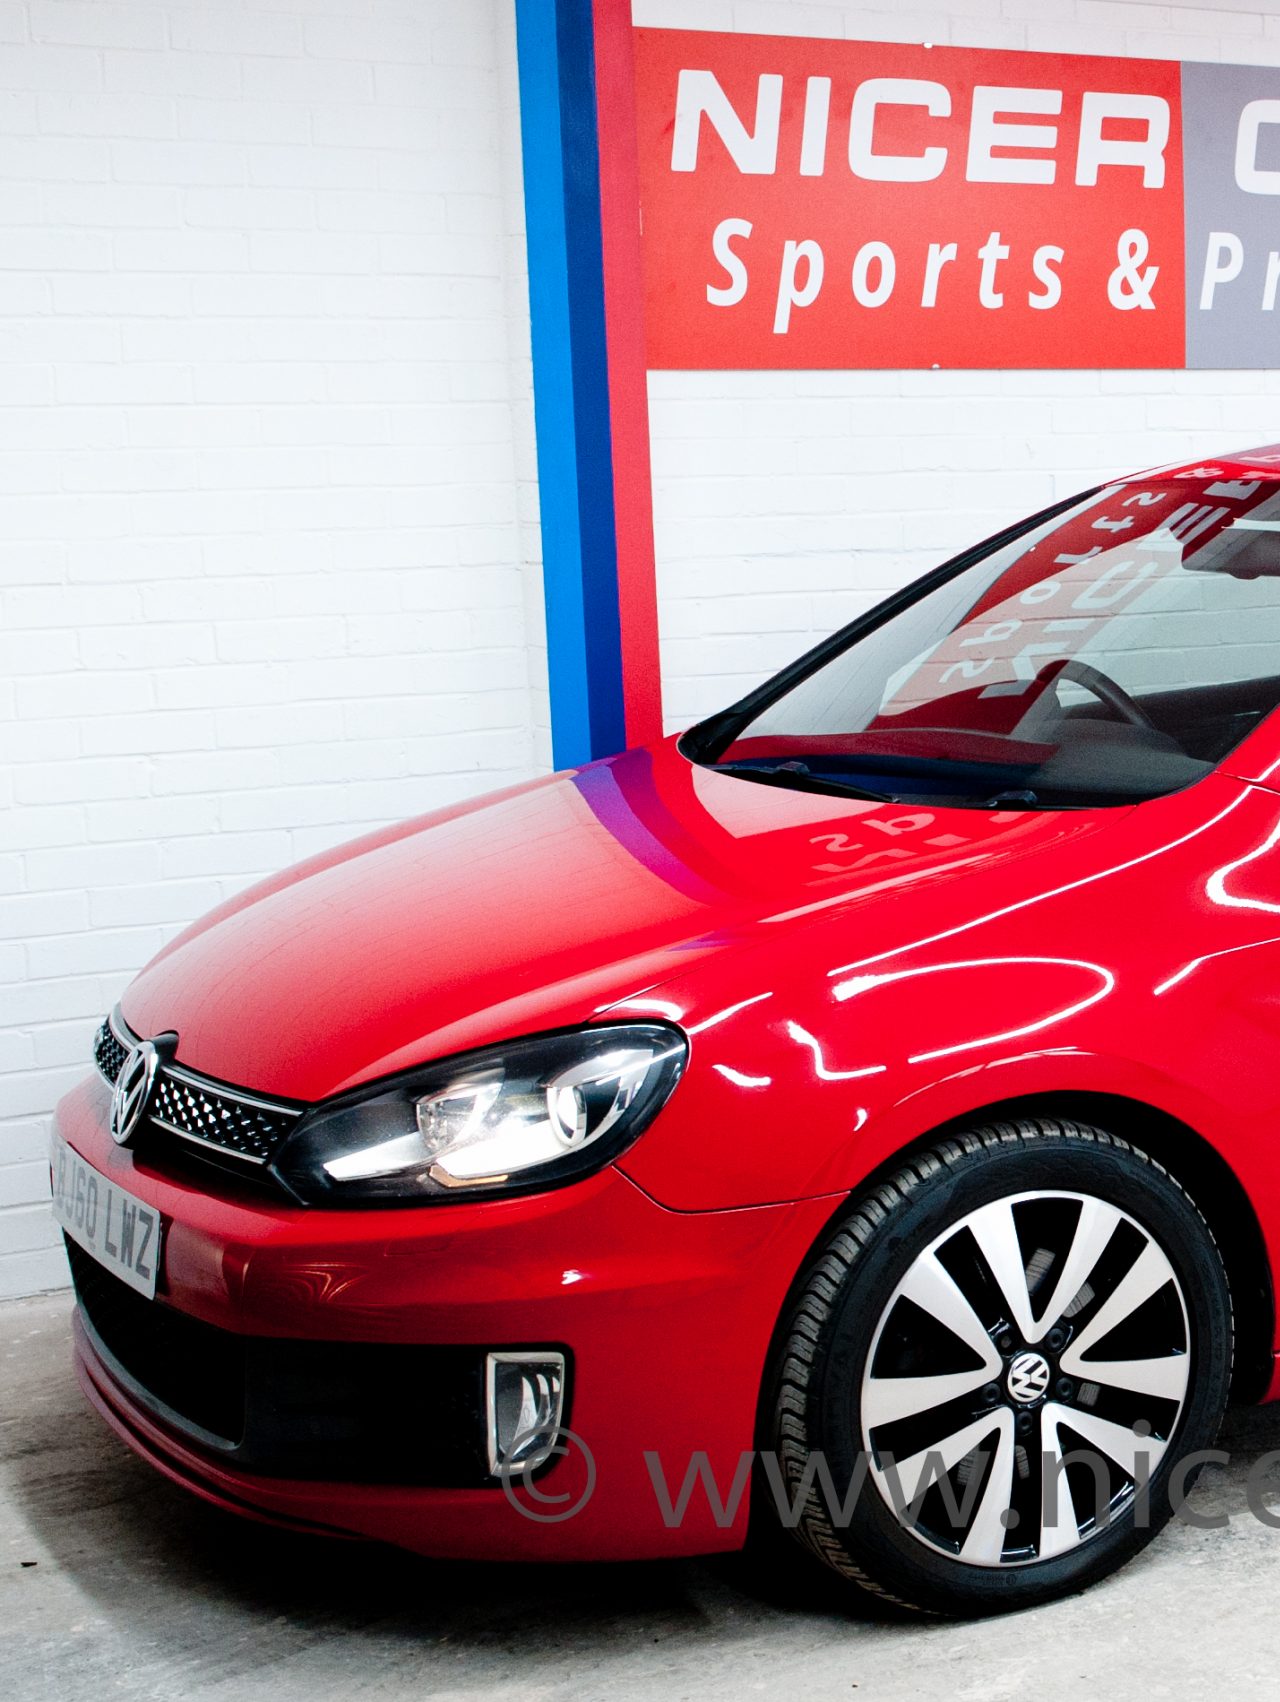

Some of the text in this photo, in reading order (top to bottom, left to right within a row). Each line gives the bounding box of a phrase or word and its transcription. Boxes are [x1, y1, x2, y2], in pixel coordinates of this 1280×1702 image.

[671, 69, 1171, 189] NICER
[706, 217, 1065, 334] Sports
[1107, 228, 1159, 311] &
[104, 1188, 154, 1281] LWZ
